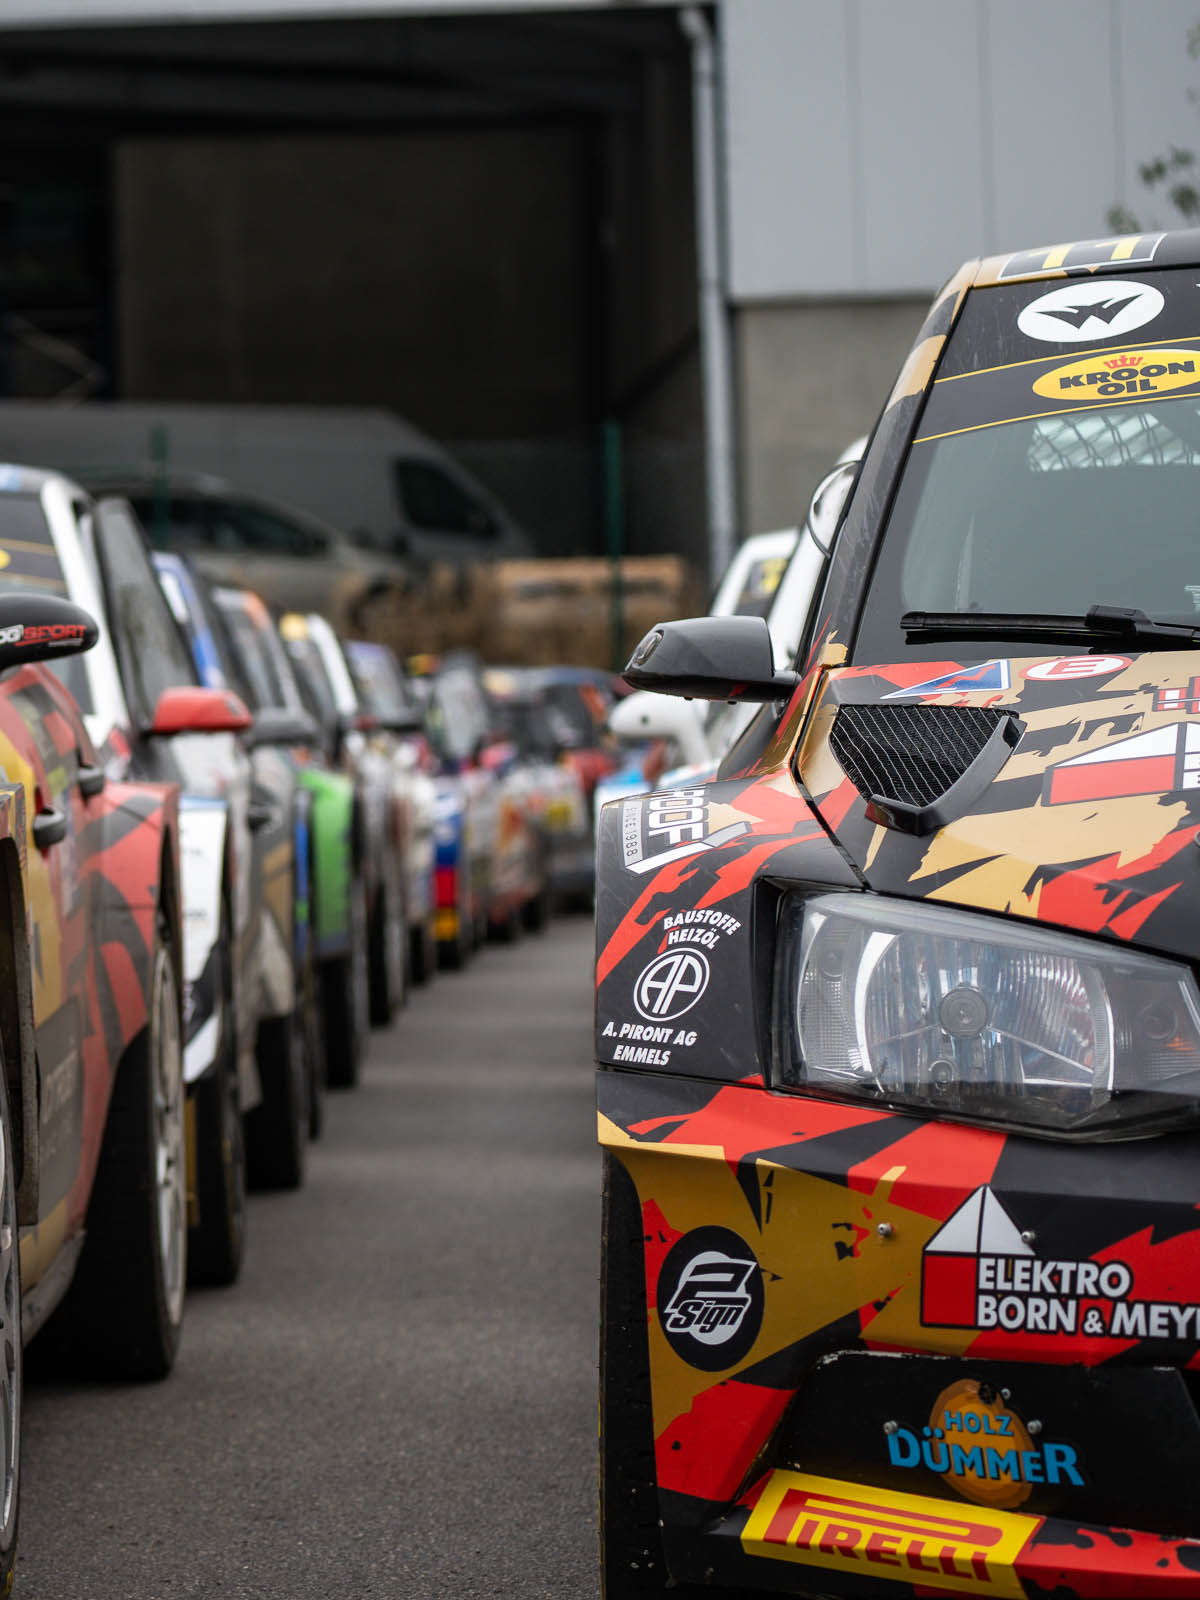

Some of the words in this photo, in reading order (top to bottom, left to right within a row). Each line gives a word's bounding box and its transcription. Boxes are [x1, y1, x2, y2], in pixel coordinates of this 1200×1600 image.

[1059, 361, 1196, 389] KROON
[1097, 379, 1157, 396] OIL
[625, 830, 638, 857] 1988
[663, 909, 742, 936] BAUSTOFFE
[667, 928, 720, 950] HEIZÖL
[602, 1021, 618, 1037] A.
[618, 1023, 674, 1044] PIRONT
[673, 1030, 698, 1047] AG
[613, 1044, 672, 1066] EMMELS
[978, 1257, 1131, 1298] ELEKTRO
[669, 1301, 745, 1334] Sign
[977, 1294, 1076, 1332] BORN
[1083, 1309, 1104, 1334] &
[1111, 1301, 1200, 1339] MEY
[943, 1410, 1015, 1437] HOLZ
[887, 1426, 1085, 1487] DÜMMER
[763, 1488, 1004, 1583] PIRELLI
